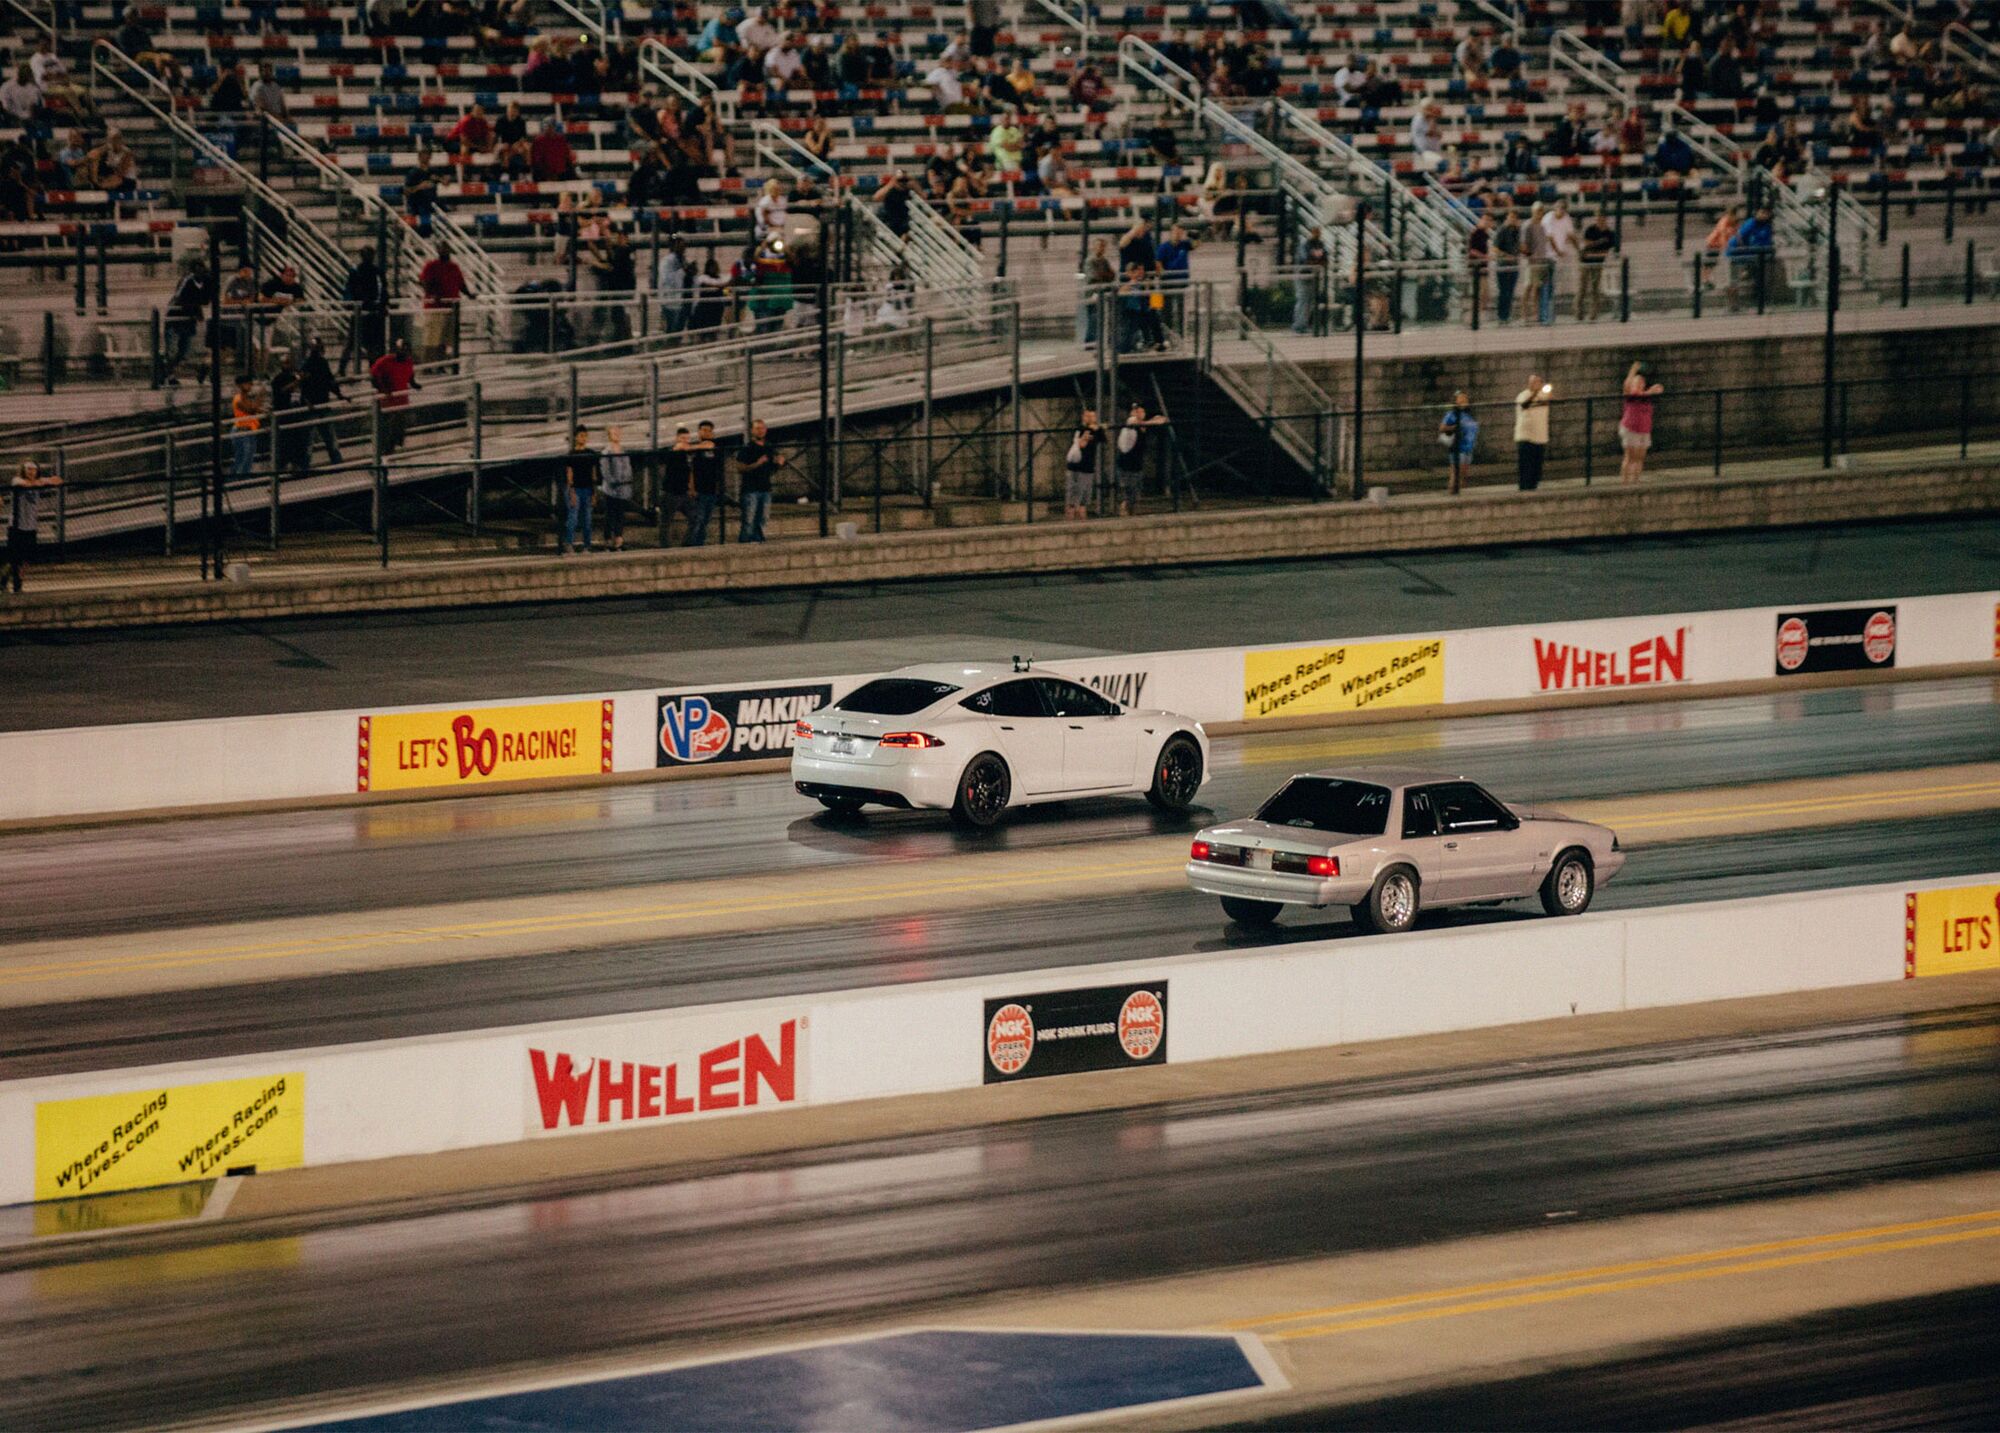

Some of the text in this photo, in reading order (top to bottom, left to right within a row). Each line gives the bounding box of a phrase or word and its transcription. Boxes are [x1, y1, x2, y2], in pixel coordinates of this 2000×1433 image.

[1245, 648, 1345, 704] Where Racing
[1341, 641, 1440, 696] Where Racing
[1533, 626, 1686, 690] WHELEN
[1260, 673, 1331, 715] Lives.com
[1356, 666, 1426, 707] Lives.com
[399, 715, 576, 779] LET'S BO RACING!
[662, 696, 711, 759] VP
[732, 724, 797, 752] POWE
[1943, 915, 1992, 953] LET'S
[995, 1019, 1025, 1038] NGK
[1057, 1025, 1087, 1038] SPARK
[1086, 1022, 1116, 1035] PLUGS
[1126, 1005, 1155, 1024] NGK
[528, 1018, 796, 1130] WHELEN
[55, 1091, 169, 1188] Where Racing
[177, 1078, 286, 1173] Where Racing
[199, 1104, 278, 1175] Lives.com
[76, 1119, 160, 1190] Lives.com
